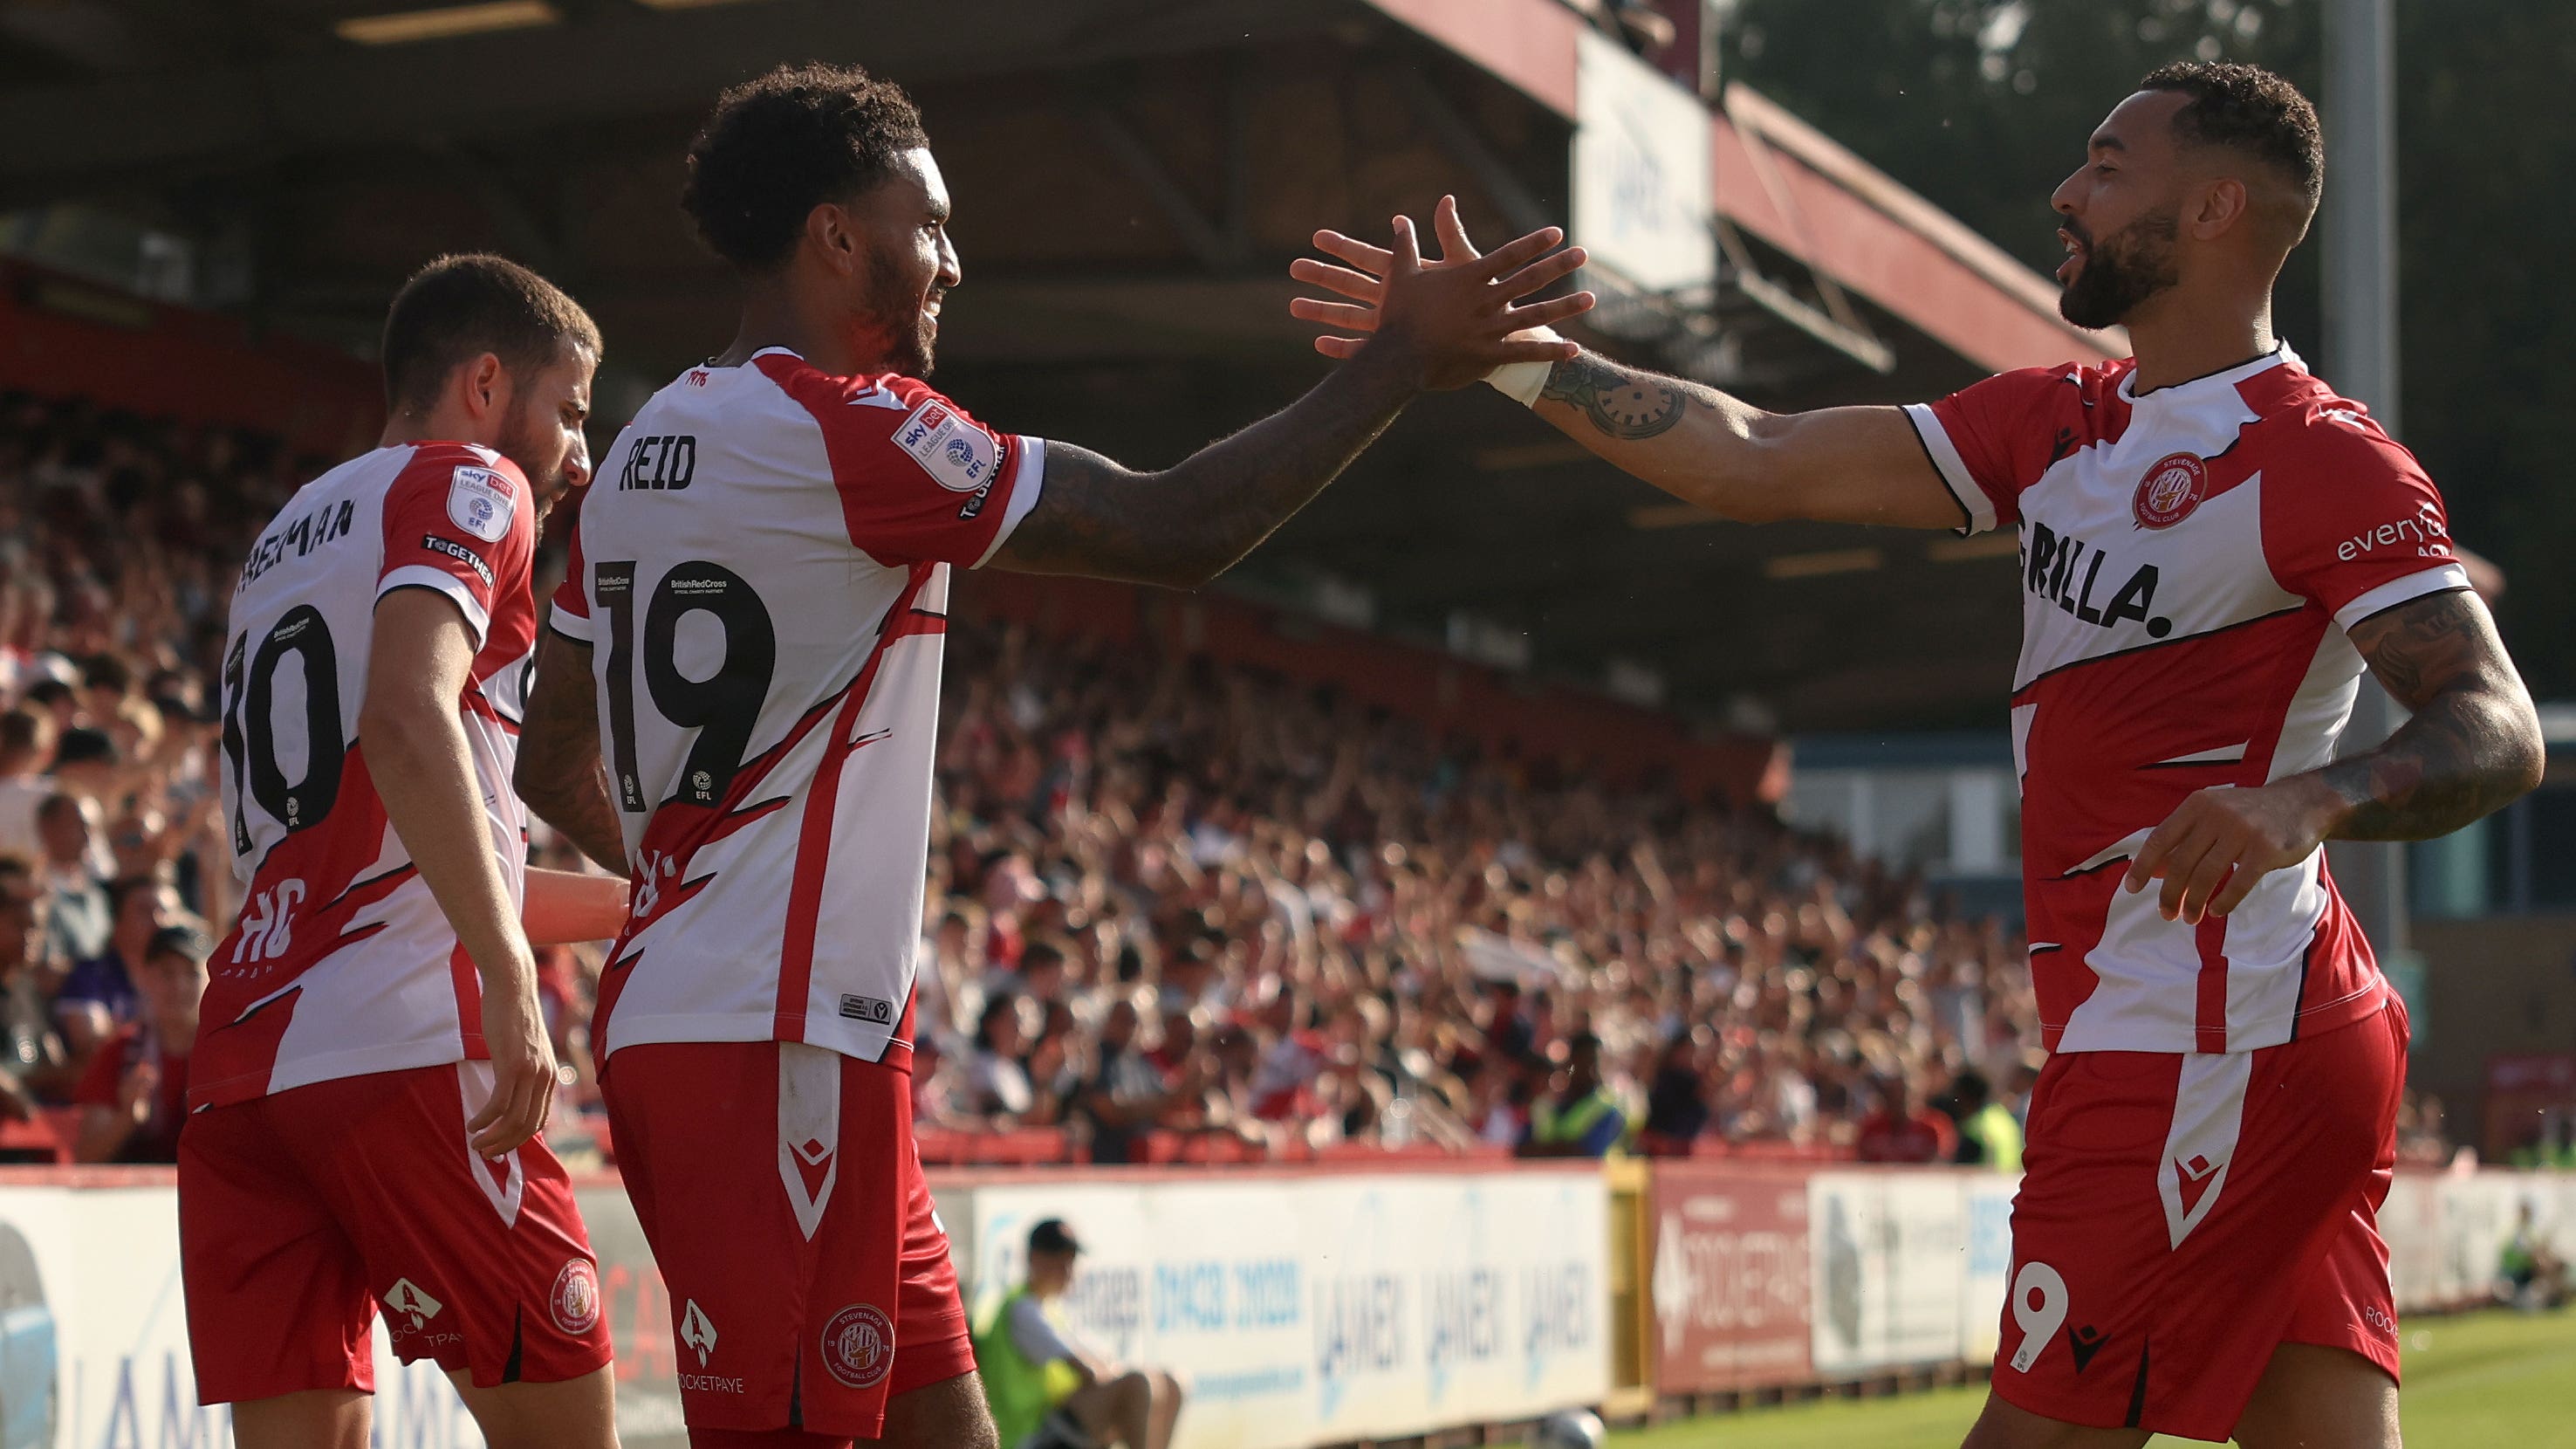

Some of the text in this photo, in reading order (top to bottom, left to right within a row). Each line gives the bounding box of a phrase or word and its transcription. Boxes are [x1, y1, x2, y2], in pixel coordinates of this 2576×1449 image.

[905, 408, 944, 447] sky bet
[920, 428, 946, 457] LEAGUE
[620, 436, 695, 491] REID
[966, 459, 986, 478] EFL
[2164, 458, 2200, 476] STEVENAGE
[460, 479, 492, 498] LEAGUE
[461, 470, 511, 496] sky bet
[2140, 502, 2180, 523] FOOTBALL CLUB
[469, 517, 486, 532] EFL
[595, 561, 776, 812] 19
[223, 604, 345, 856] 10
[695, 791, 711, 800] EFL
[839, 1312, 882, 1328] STEVENAGE
[833, 1363, 866, 1379] FOOTBALL
[679, 1373, 744, 1393] OCKETPAYE
